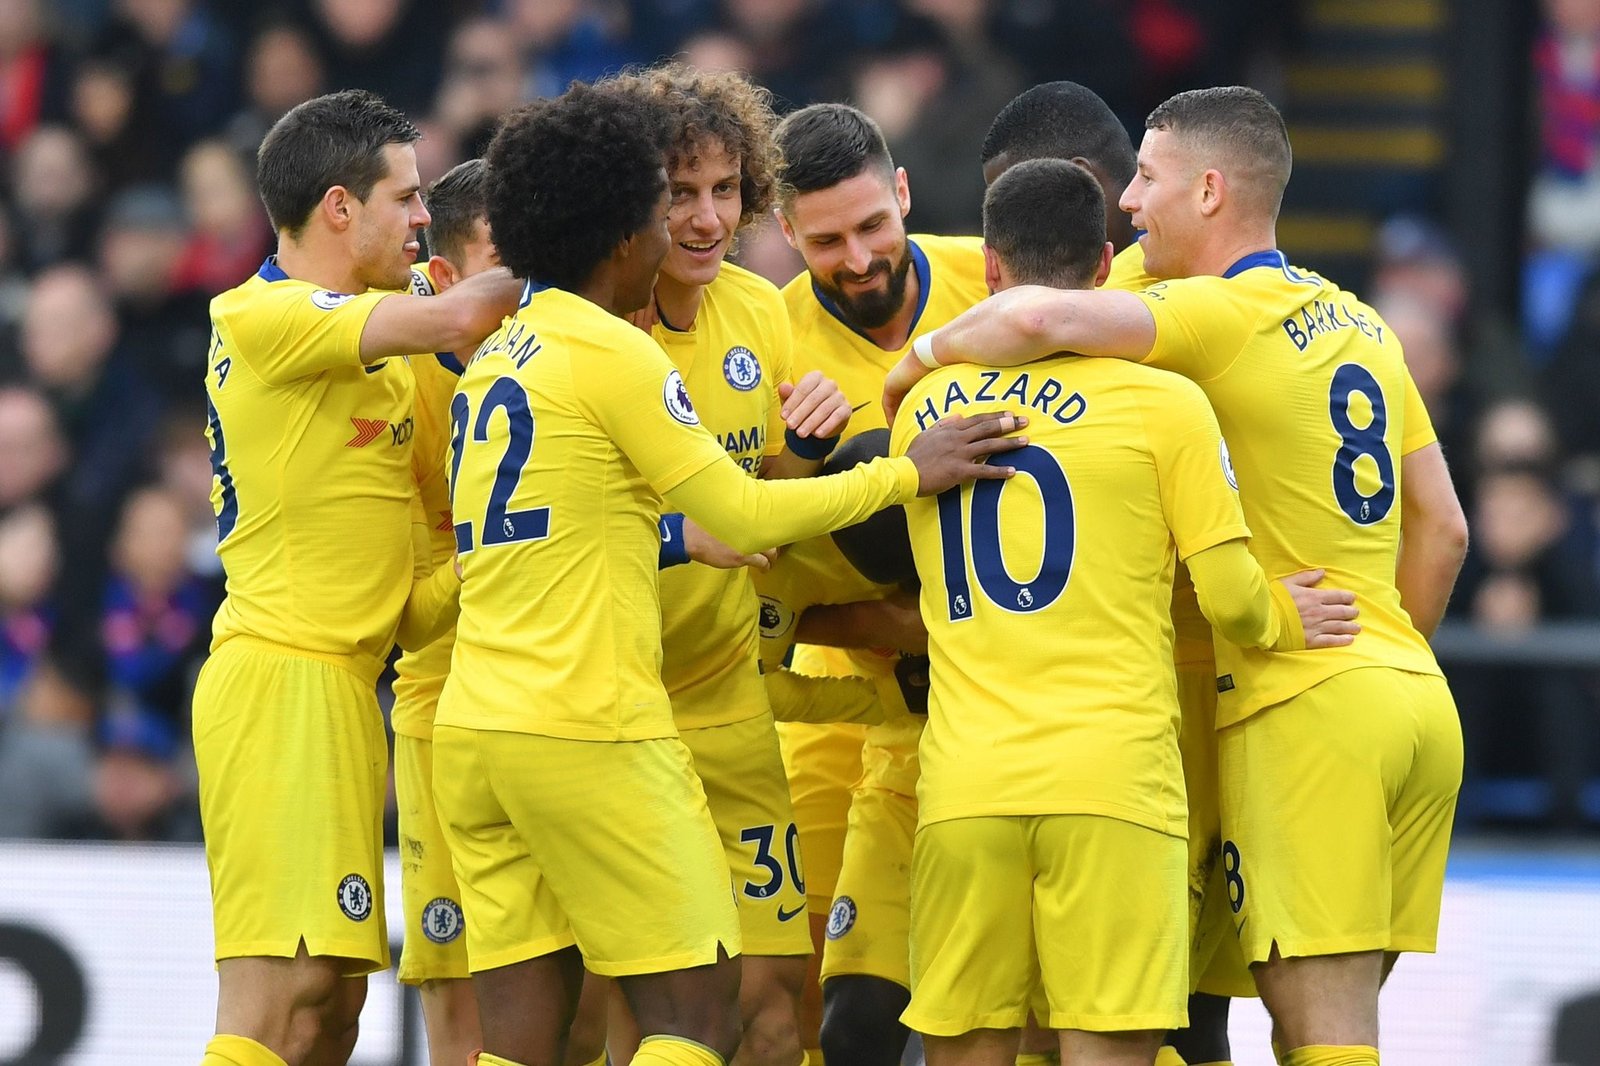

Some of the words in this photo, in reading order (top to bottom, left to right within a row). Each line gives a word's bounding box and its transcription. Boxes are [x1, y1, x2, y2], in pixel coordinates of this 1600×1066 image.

[1282, 300, 1383, 352] BARKLEY
[915, 371, 1087, 431] HAZARD
[1328, 362, 1396, 527] 8
[936, 443, 1077, 623] 10
[740, 822, 806, 898] 30
[1222, 840, 1245, 914] 8
